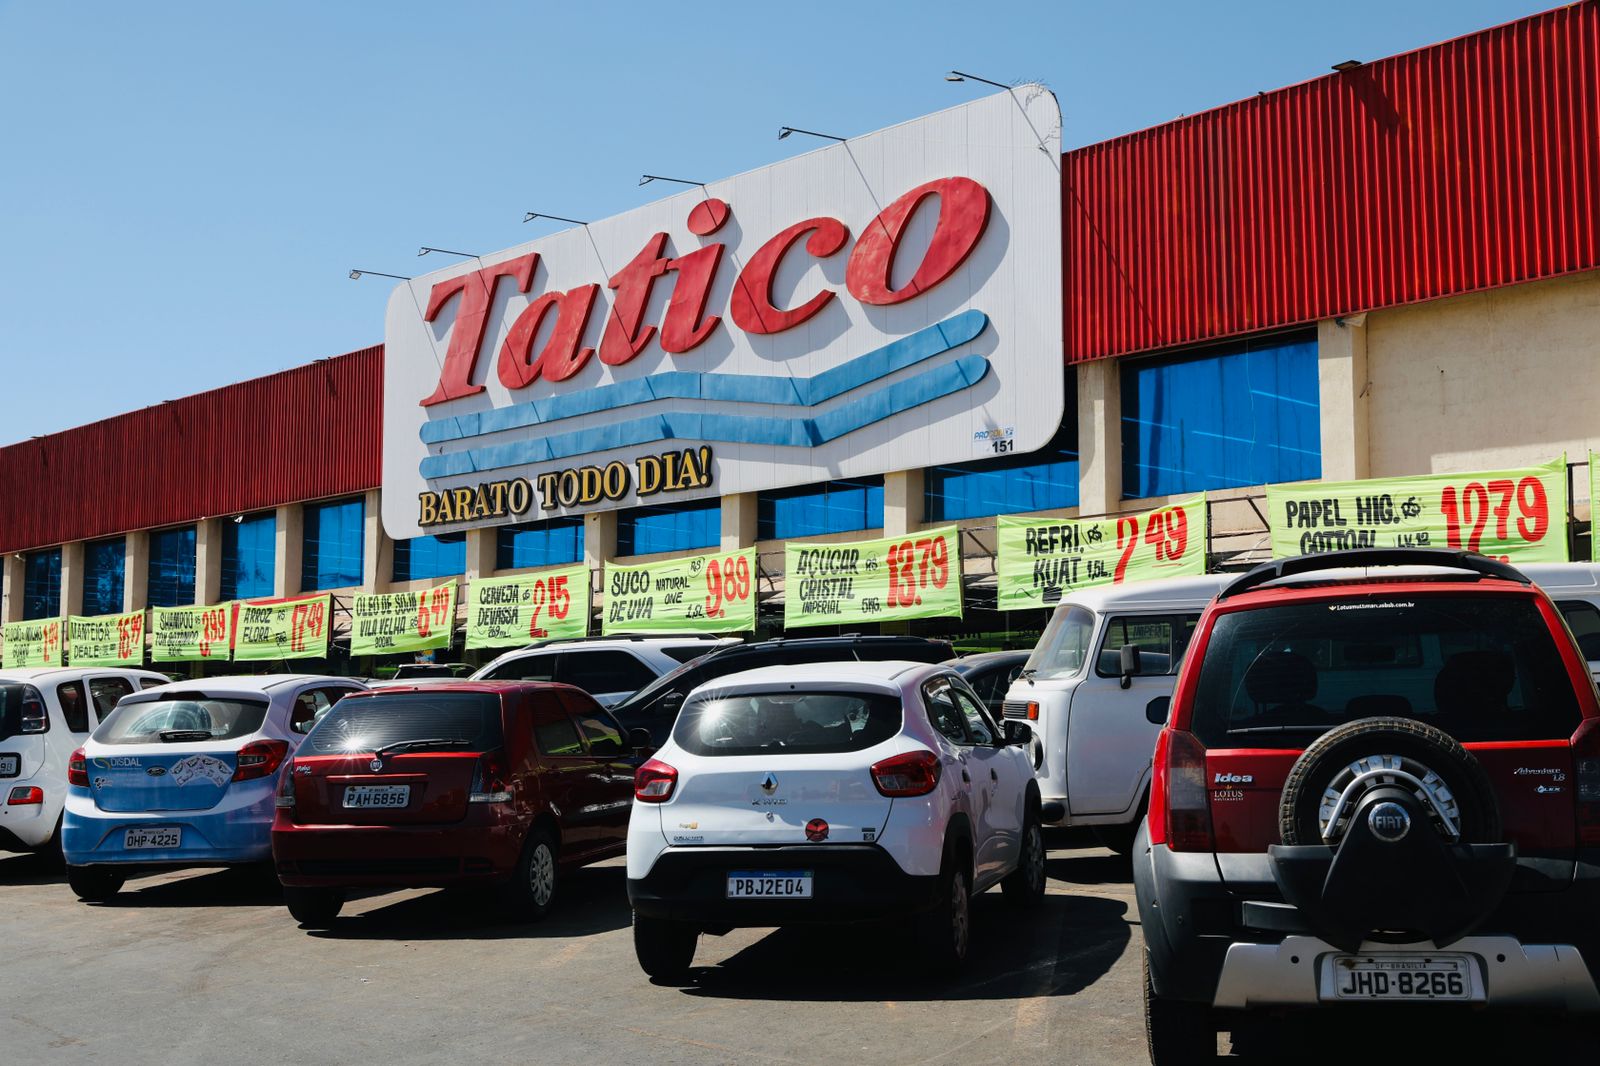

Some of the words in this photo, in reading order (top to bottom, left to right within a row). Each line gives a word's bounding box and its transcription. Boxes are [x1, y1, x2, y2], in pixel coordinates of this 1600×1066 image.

[419, 176, 991, 407] Tatico
[992, 439, 1013, 453] 151
[418, 477, 533, 526] BARATO
[537, 459, 631, 510] TODO
[636, 445, 713, 496] DIA!
[1286, 499, 1347, 528] PAPEL
[1356, 494, 1400, 525] HIG.
[1026, 524, 1085, 556] REFRI.
[1300, 529, 1376, 555] COTTON
[1033, 557, 1082, 588] KUAT
[611, 570, 650, 597] SUCO
[655, 576, 690, 591] NATURAL
[799, 577, 855, 601] CRISTAL
[395, 592, 417, 615] SOJA
[479, 584, 519, 605] CERVEJA
[664, 592, 683, 605] ONE
[243, 607, 273, 623] ARROZ
[477, 605, 519, 627] DEVASSA
[610, 600, 627, 623] DE
[627, 596, 653, 619] UVA
[802, 600, 842, 614] IMPERIAL
[159, 611, 193, 630] SHAMPOO
[360, 619, 377, 637] VILA
[379, 616, 406, 635] VELHA
[71, 622, 110, 641] MANTEIGA
[243, 626, 269, 643] FLORA
[1214, 773, 1253, 783] Idea
[1214, 790, 1244, 798] LOTUS
[1375, 816, 1402, 829] FIAT
[736, 879, 803, 895] PBJ2E04
